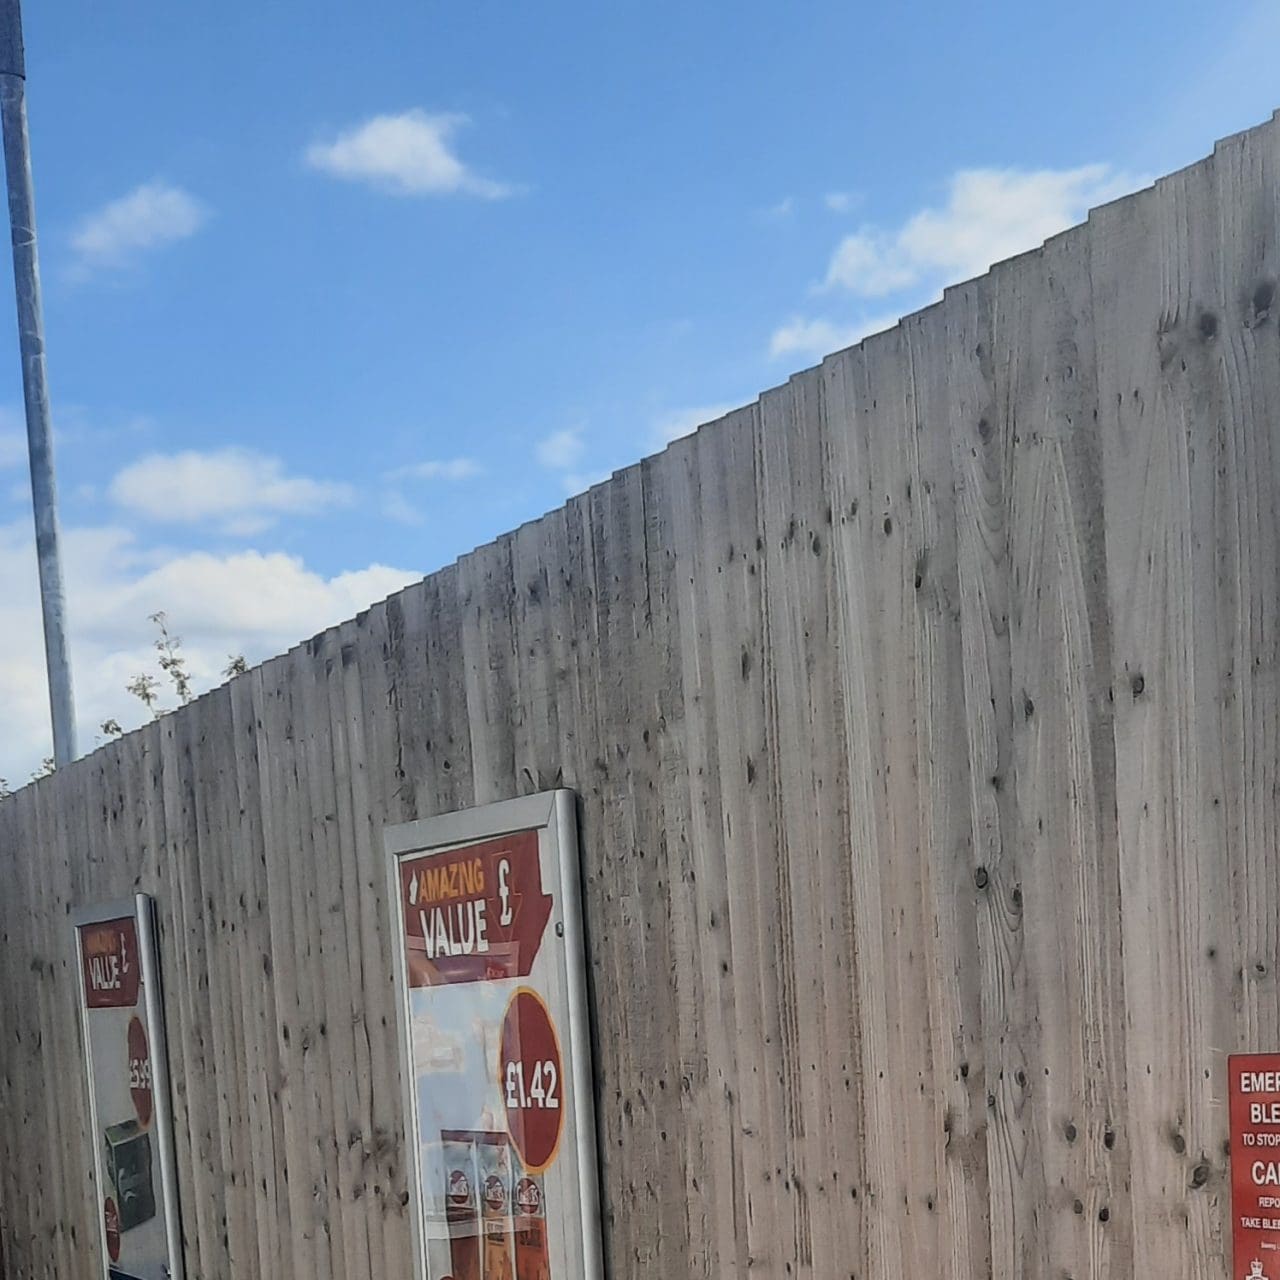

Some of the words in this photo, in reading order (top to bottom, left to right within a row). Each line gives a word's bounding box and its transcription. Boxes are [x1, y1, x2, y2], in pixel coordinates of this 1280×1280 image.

[420, 899, 489, 959] VALUE
[506, 1060, 558, 1108] £1.42
[1242, 1133, 1255, 1146] TO
[1240, 1216, 1261, 1228] TAKE
